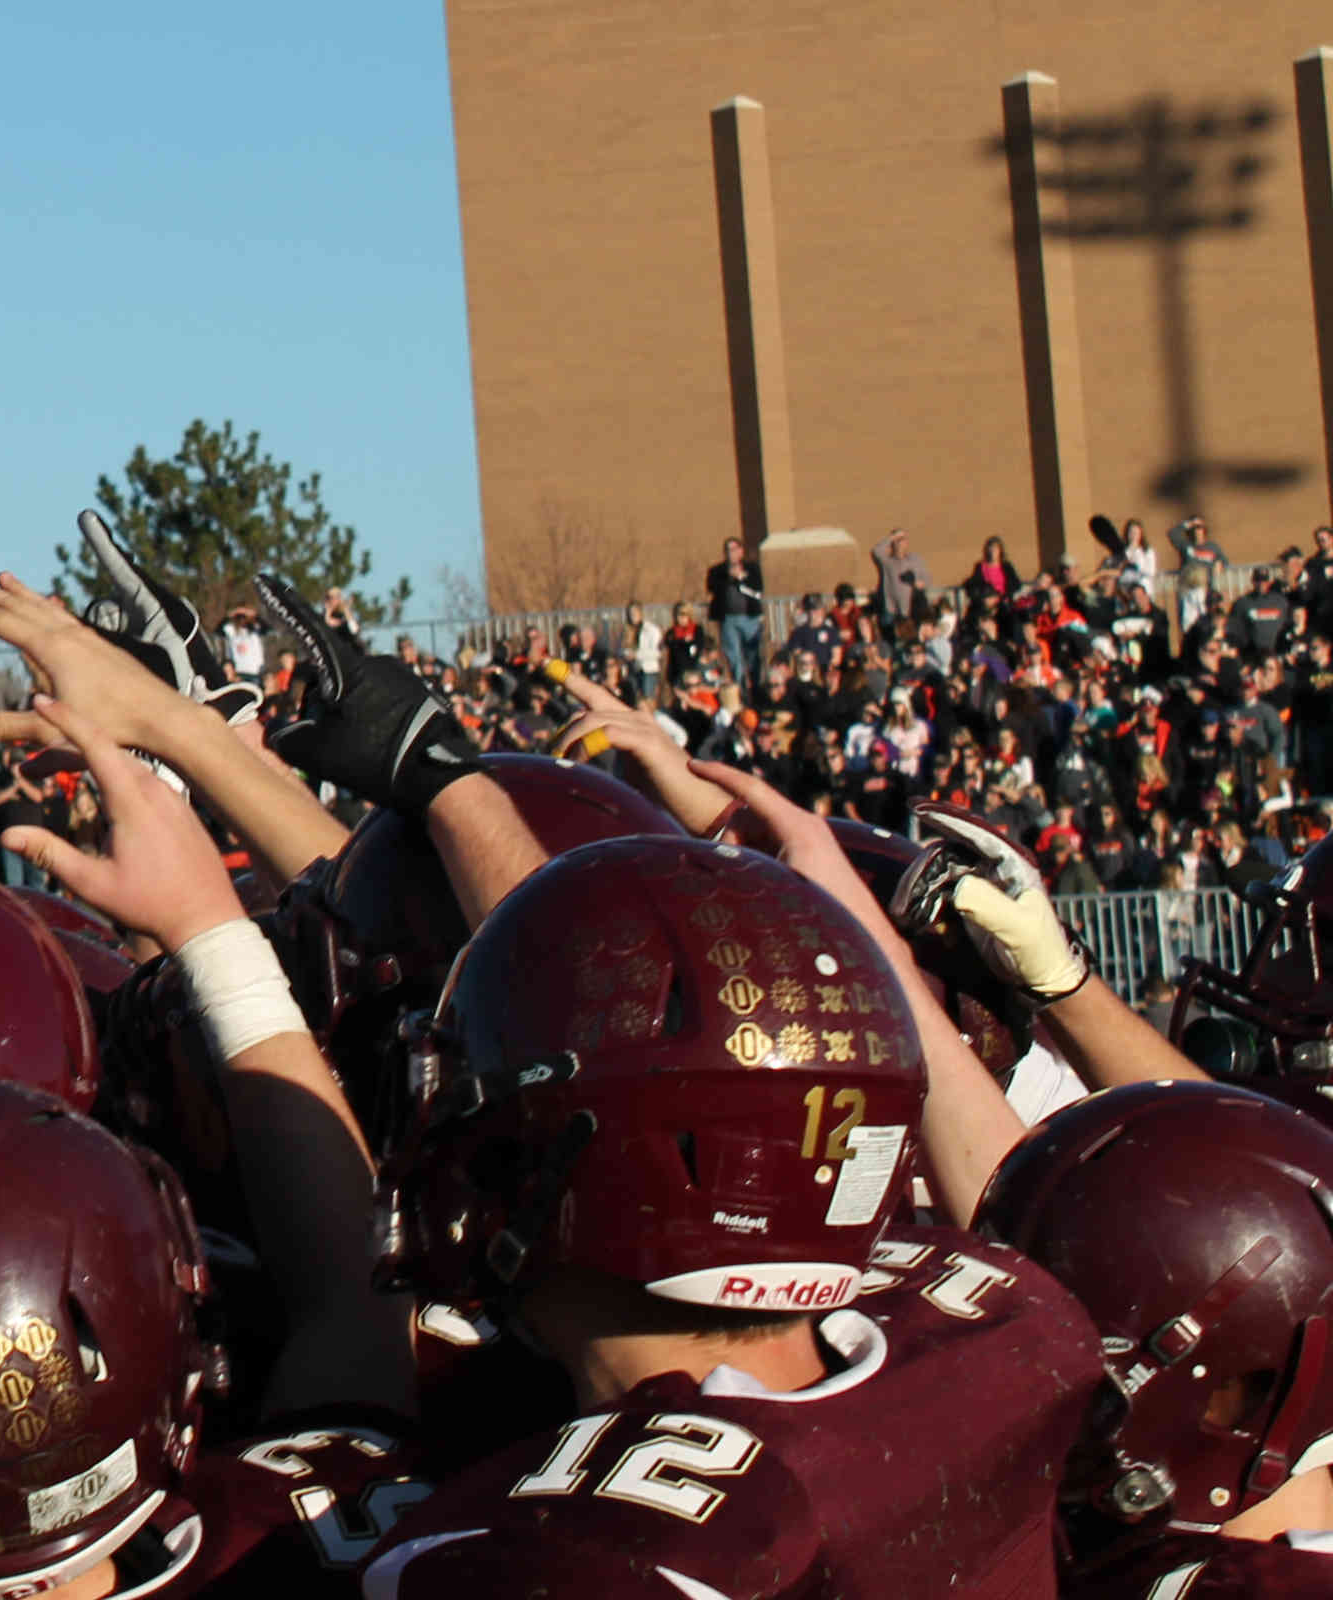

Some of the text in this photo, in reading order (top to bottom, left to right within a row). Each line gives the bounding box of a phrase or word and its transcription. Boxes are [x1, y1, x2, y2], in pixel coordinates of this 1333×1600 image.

[801, 1085, 866, 1160] 12
[717, 1275, 853, 1306] Riddell
[509, 1411, 763, 1523] 12
